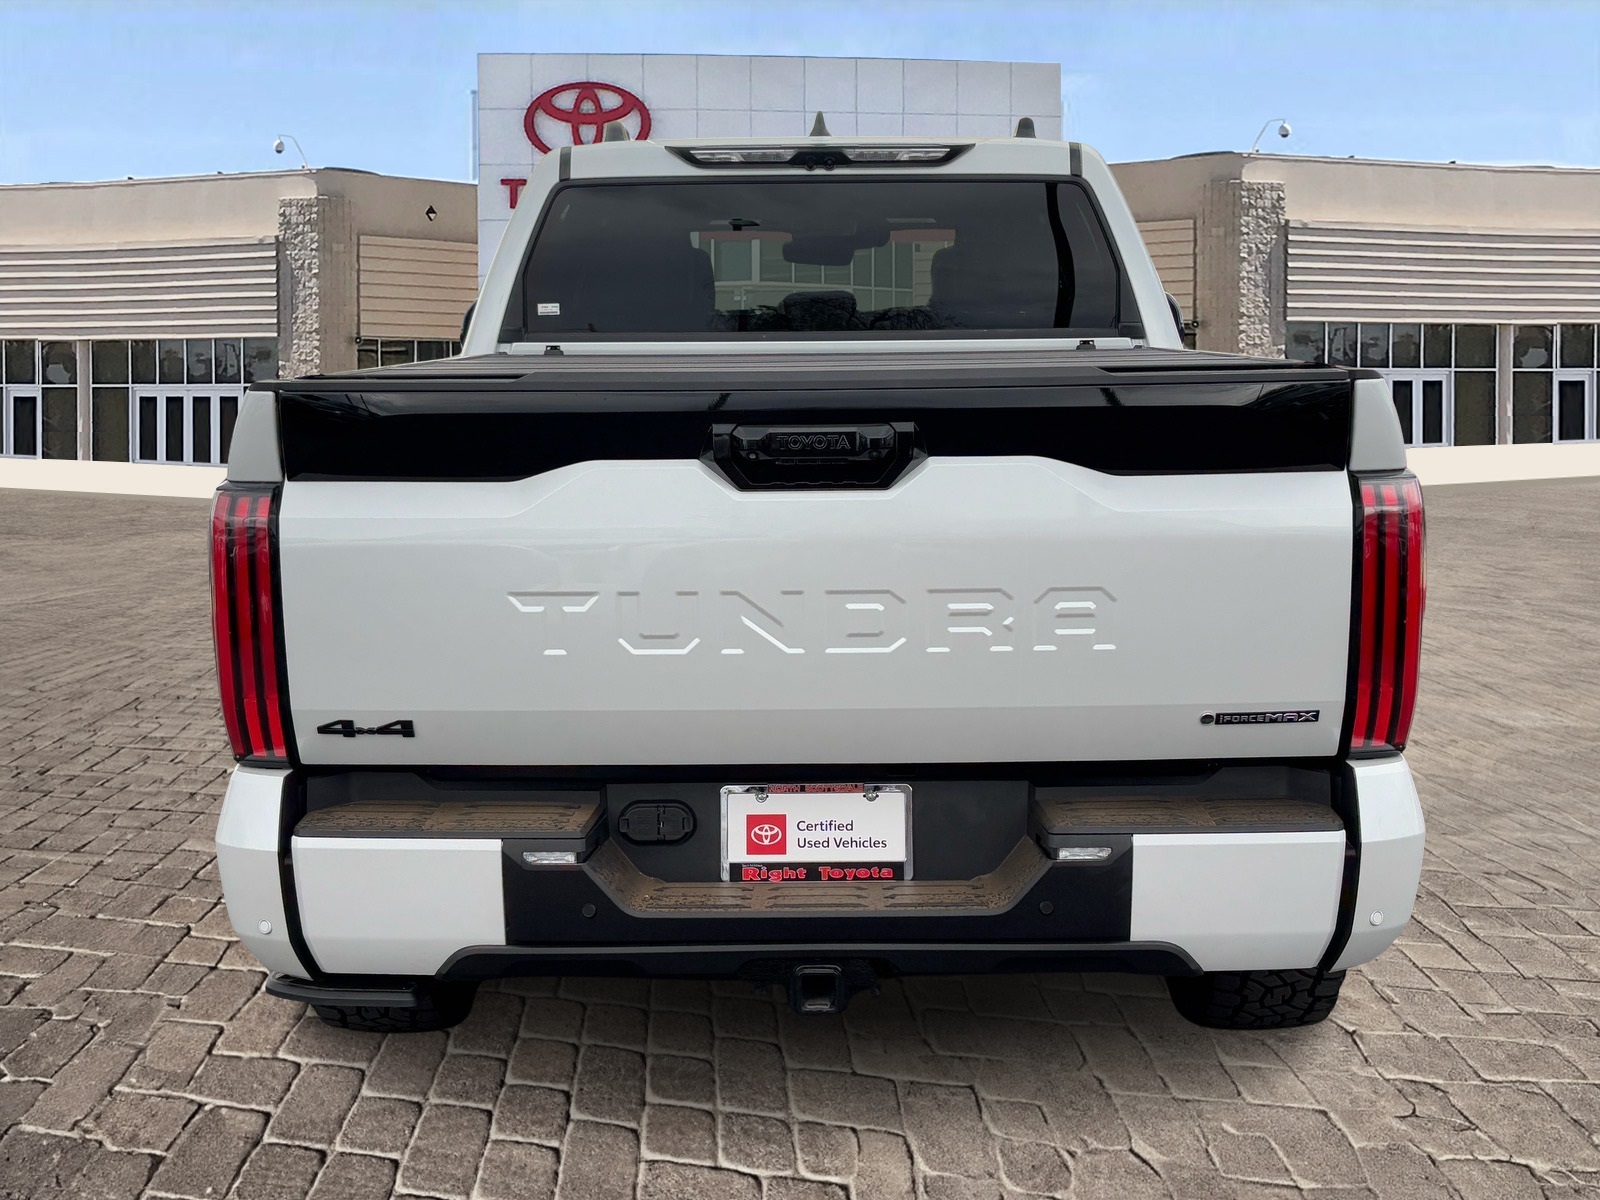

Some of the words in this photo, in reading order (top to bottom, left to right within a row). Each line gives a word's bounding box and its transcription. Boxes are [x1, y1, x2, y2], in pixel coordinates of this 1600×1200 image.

[776, 434, 851, 450] TOYOTA
[507, 585, 1119, 656] TUNDRA
[769, 785, 801, 793] NORTH
[804, 784, 864, 793] SCOTTSDALE
[796, 820, 854, 832] Certified
[797, 837, 830, 849] Used
[833, 837, 888, 849] Vehicles
[741, 867, 808, 883] Right
[818, 866, 894, 881] Toyota
